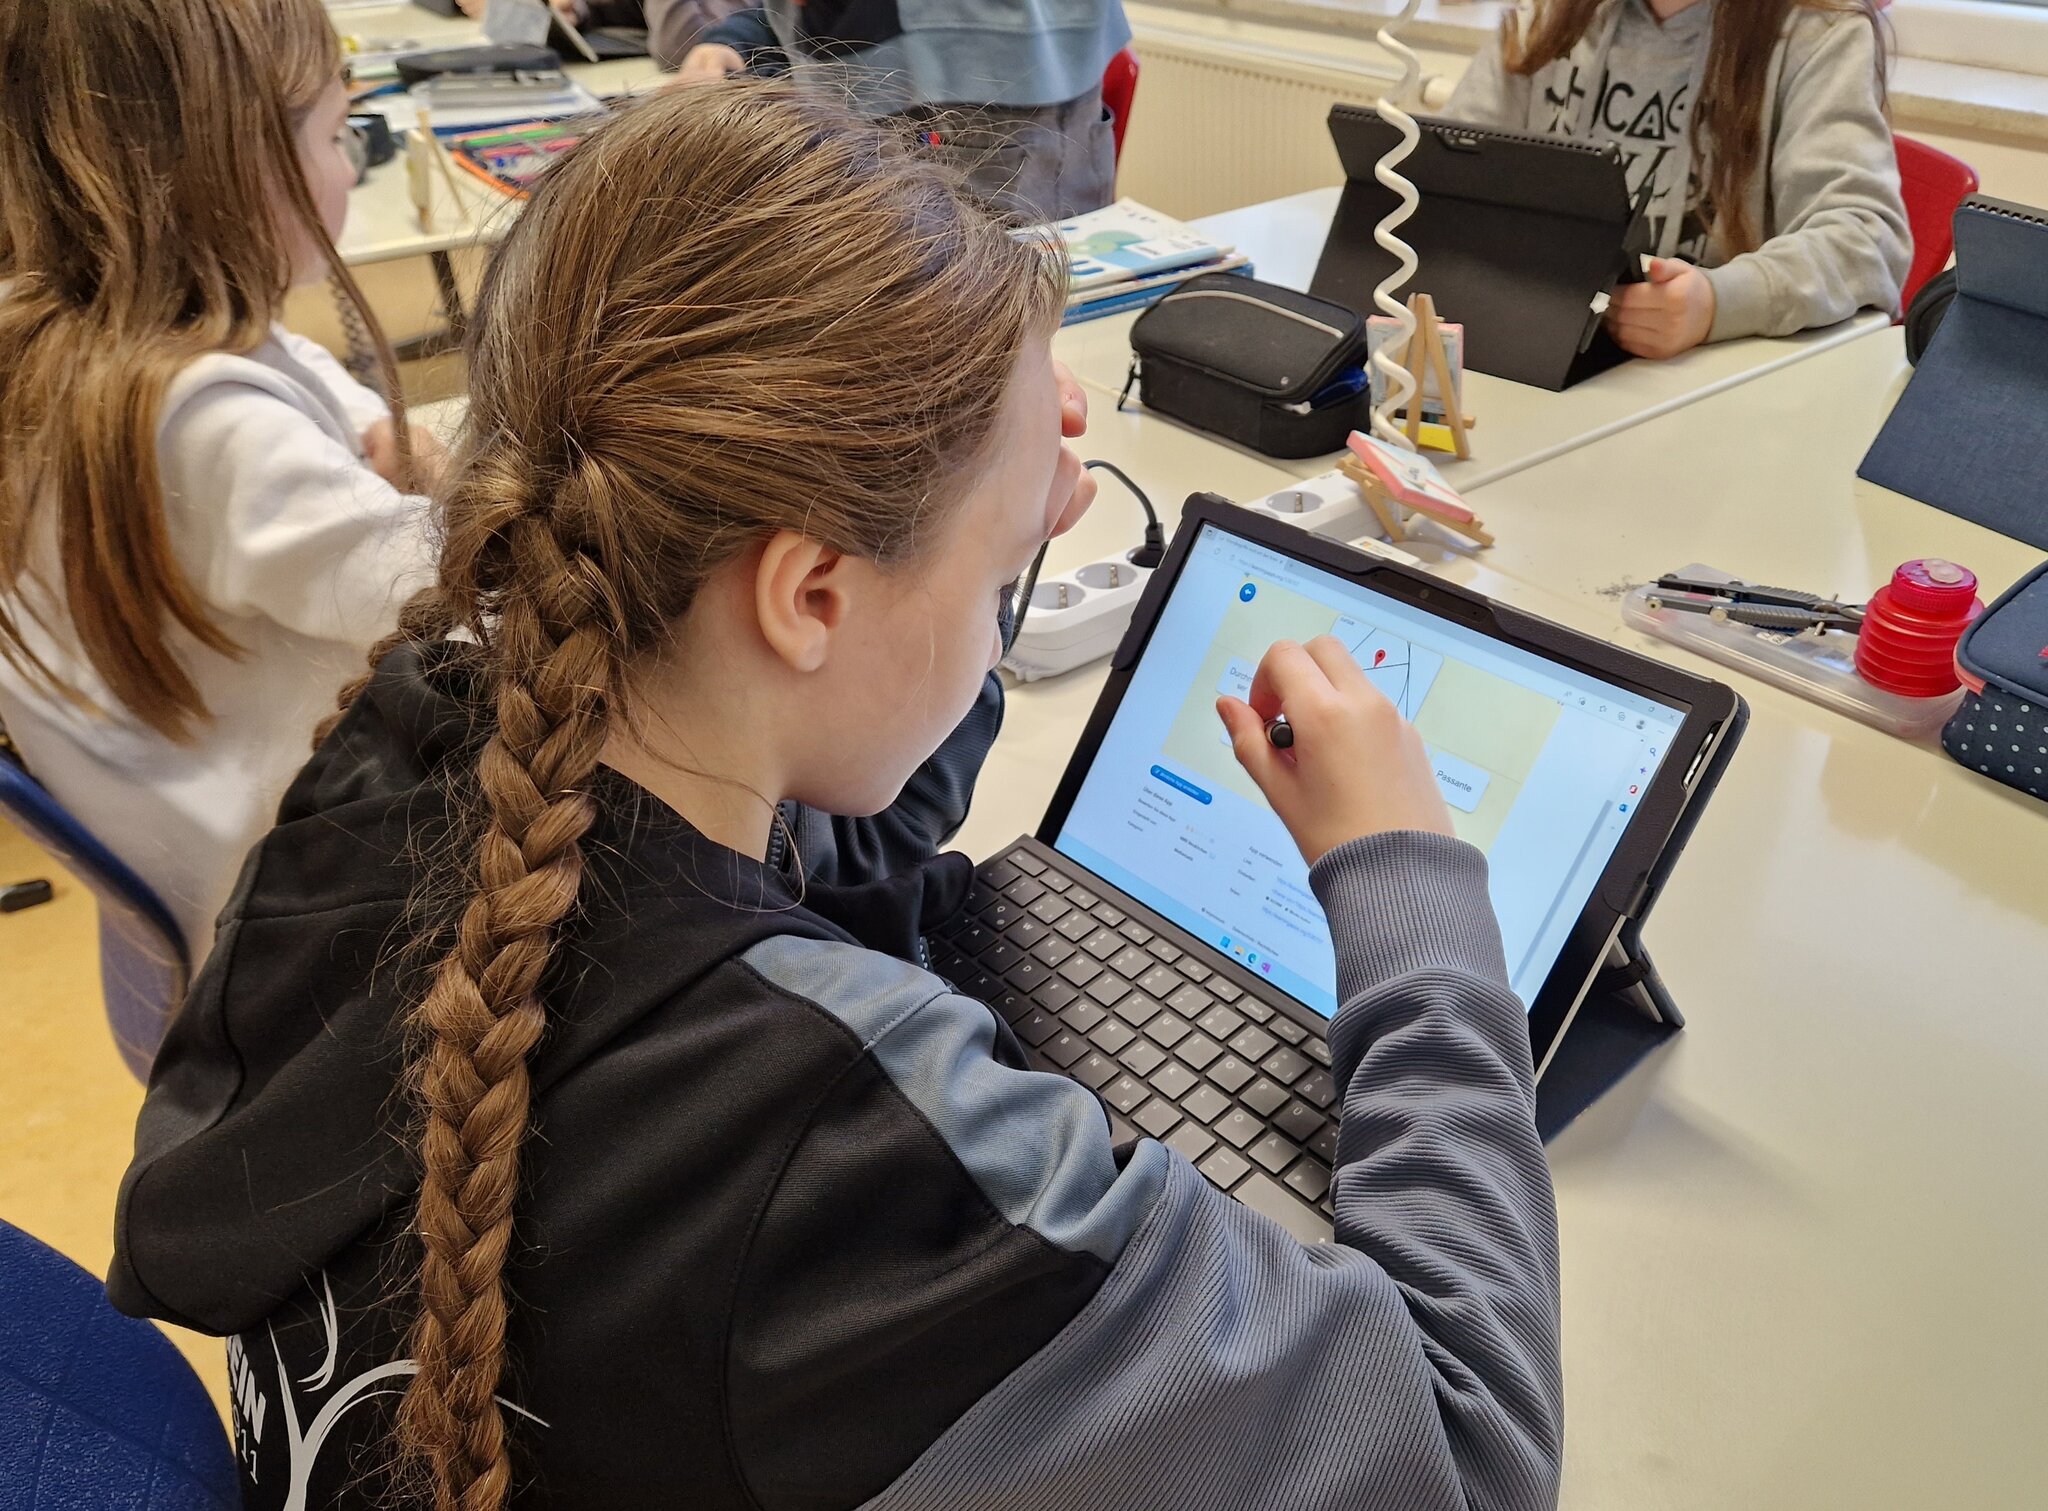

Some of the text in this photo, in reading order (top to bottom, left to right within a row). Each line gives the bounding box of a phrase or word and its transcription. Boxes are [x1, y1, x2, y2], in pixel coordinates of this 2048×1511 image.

[1436, 769, 1472, 793] Passante
[227, 1334, 266, 1445] EIN
[230, 1388, 259, 1485] 911
